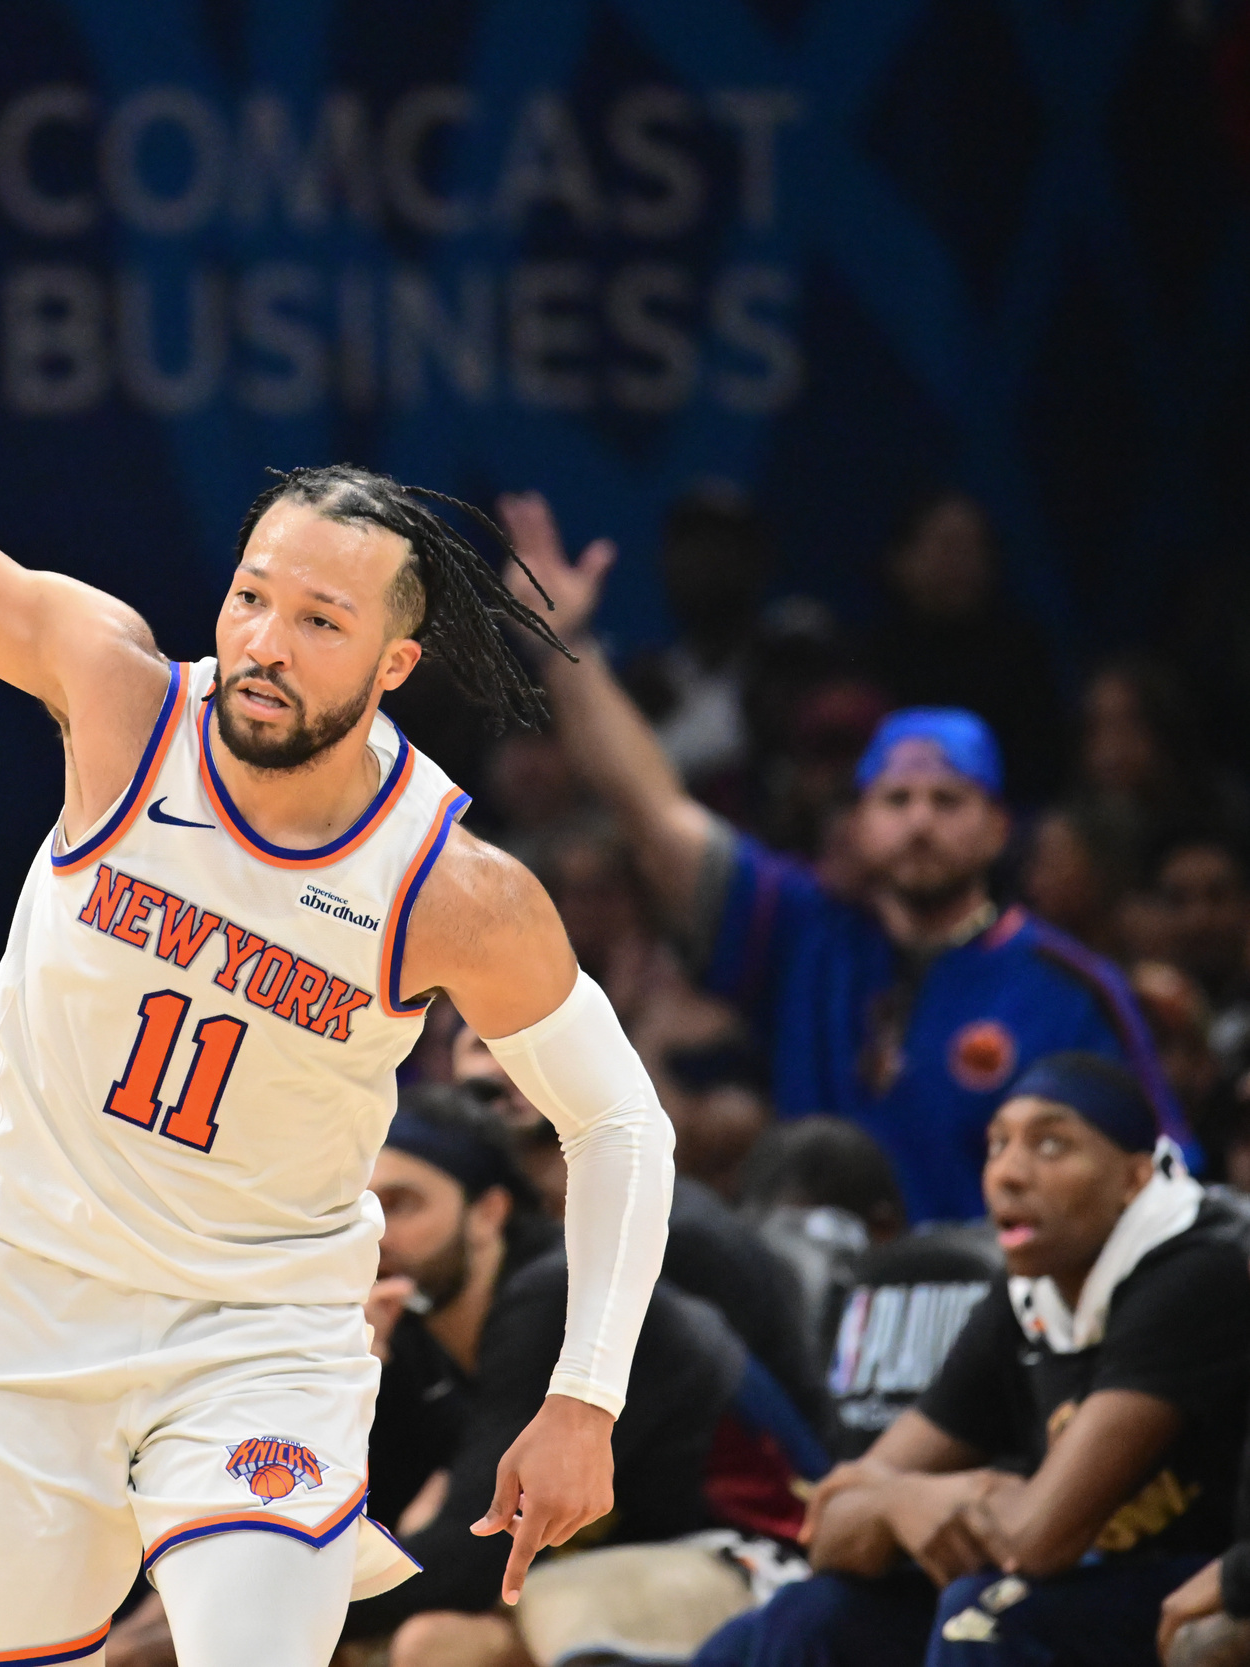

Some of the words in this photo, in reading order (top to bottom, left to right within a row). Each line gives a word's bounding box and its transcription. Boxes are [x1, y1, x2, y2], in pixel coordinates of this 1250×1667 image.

[0, 261, 804, 414] BUSINESS
[299, 894, 332, 914] abu
[306, 884, 349, 905] experience
[76, 862, 221, 973] NEW
[211, 922, 376, 1044] YORK
[102, 989, 249, 1154] 11
[226, 1437, 323, 1489] KNICKS
